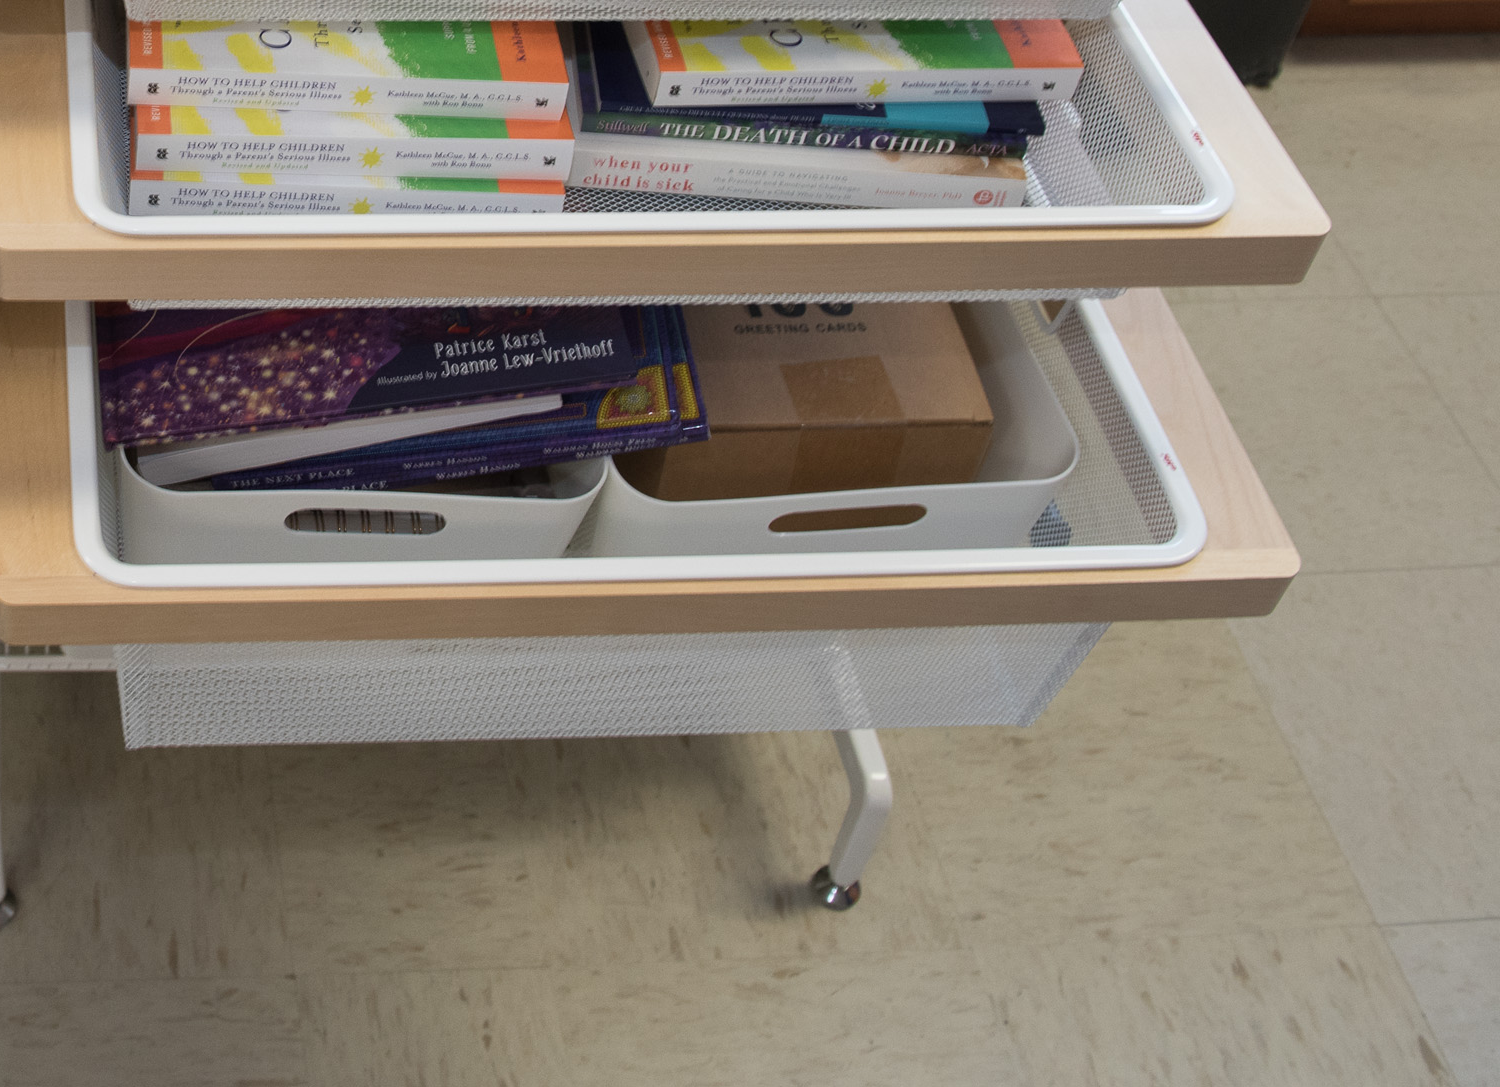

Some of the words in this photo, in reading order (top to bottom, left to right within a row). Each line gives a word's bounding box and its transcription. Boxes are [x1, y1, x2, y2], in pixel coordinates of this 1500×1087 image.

[178, 76, 209, 86] HOW
[212, 77, 230, 86] TO
[234, 78, 267, 87] HELP
[270, 79, 337, 90] CHILDREN
[700, 77, 731, 85] HOW
[733, 77, 751, 85] TO
[754, 77, 787, 85] HELP
[789, 76, 854, 85] CHILDREN
[170, 85, 214, 96] Through
[226, 87, 265, 97] Parent's
[271, 89, 306, 98] Serious
[310, 90, 343, 100] Illness
[692, 86, 734, 95] Through
[746, 86, 783, 94] Parent's
[597, 119, 650, 133] Stillwell
[660, 122, 705, 138] THE
[712, 124, 811, 145] DEATH
[815, 132, 846, 147] OF
[848, 134, 863, 148] A
[870, 134, 956, 154] CHILD
[187, 141, 218, 151] HOW
[221, 142, 239, 151] TO
[243, 142, 275, 151] HELP
[279, 143, 345, 152] CHILDREN
[179, 150, 224, 160] Through
[235, 151, 274, 160] Parent's
[277, 152, 315, 161] Serious
[318, 153, 351, 162] Illness
[593, 155, 642, 170] when
[647, 161, 694, 174] your
[581, 173, 631, 188] child
[636, 175, 650, 189] is
[655, 178, 695, 192] sick
[178, 187, 209, 197] HOW
[212, 188, 230, 197] TO
[233, 189, 266, 199] HELP
[269, 191, 335, 202] CHILDREN
[171, 197, 214, 208] Through
[226, 199, 264, 208] Parent's
[268, 201, 305, 210] Serious
[308, 202, 341, 212] Illness
[733, 323, 810, 335] GREETING
[815, 321, 868, 334] CARDS
[433, 337, 496, 359] Patrice
[501, 328, 548, 351] Karst
[377, 371, 424, 386] Illustrated
[425, 370, 438, 381] by
[440, 357, 499, 378] Joanne
[502, 339, 615, 370] Lew-Vriethoff
[230, 477, 261, 489] THE
[264, 473, 304, 485] NEXT
[308, 467, 356, 480] PLACE
